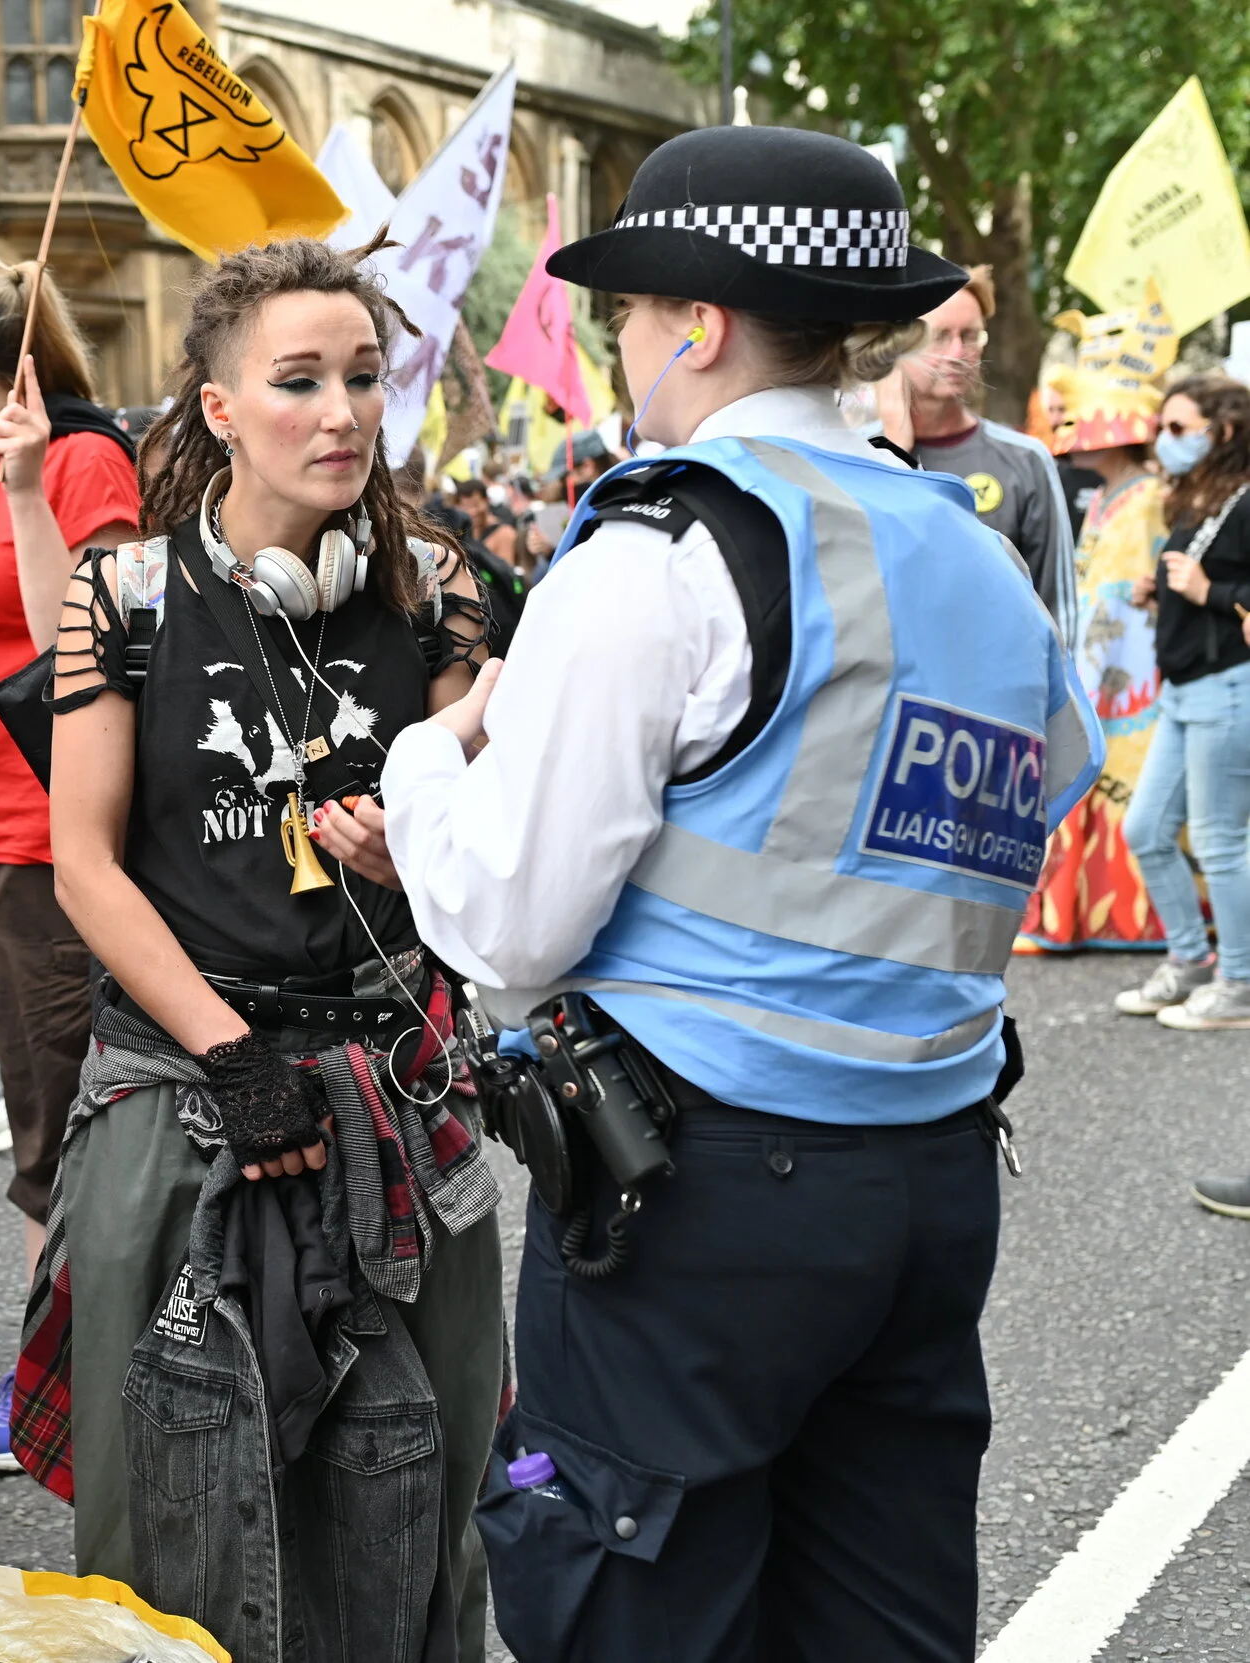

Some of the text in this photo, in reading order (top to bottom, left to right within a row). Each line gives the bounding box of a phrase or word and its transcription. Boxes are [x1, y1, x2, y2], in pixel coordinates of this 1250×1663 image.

[178, 46, 253, 107] REBELLION
[202, 804, 269, 844] NOT
[877, 808, 1044, 875] LIAISON OFFICER
[161, 1292, 199, 1324] AUSE
[172, 1322, 201, 1338] ACTIVIST
